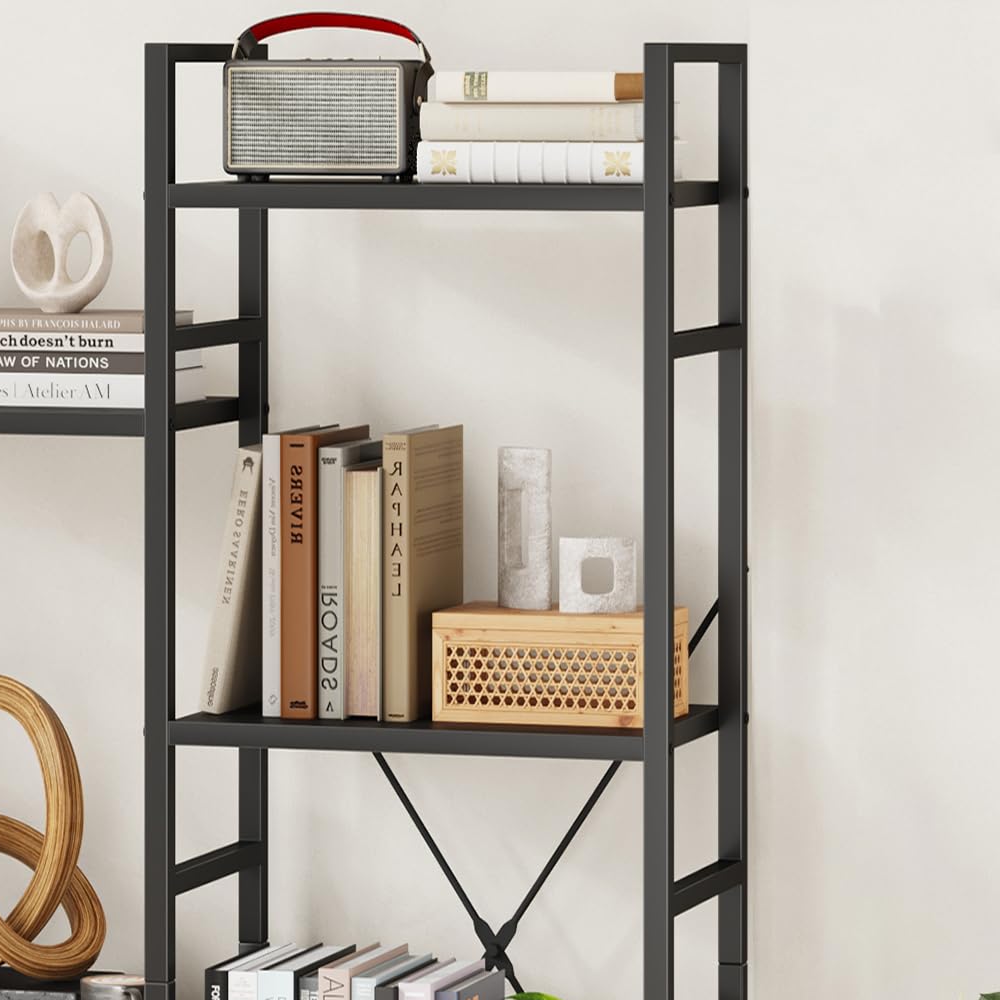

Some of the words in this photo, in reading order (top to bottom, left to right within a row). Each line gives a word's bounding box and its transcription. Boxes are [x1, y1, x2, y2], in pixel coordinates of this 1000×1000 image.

[18, 318, 30, 329] BY
[81, 319, 121, 330] HALARD
[78, 336, 114, 348] burn
[20, 356, 40, 368] OF
[45, 356, 110, 369] NATIONS
[26, 381, 78, 399] Atelier
[81, 383, 111, 399] AM
